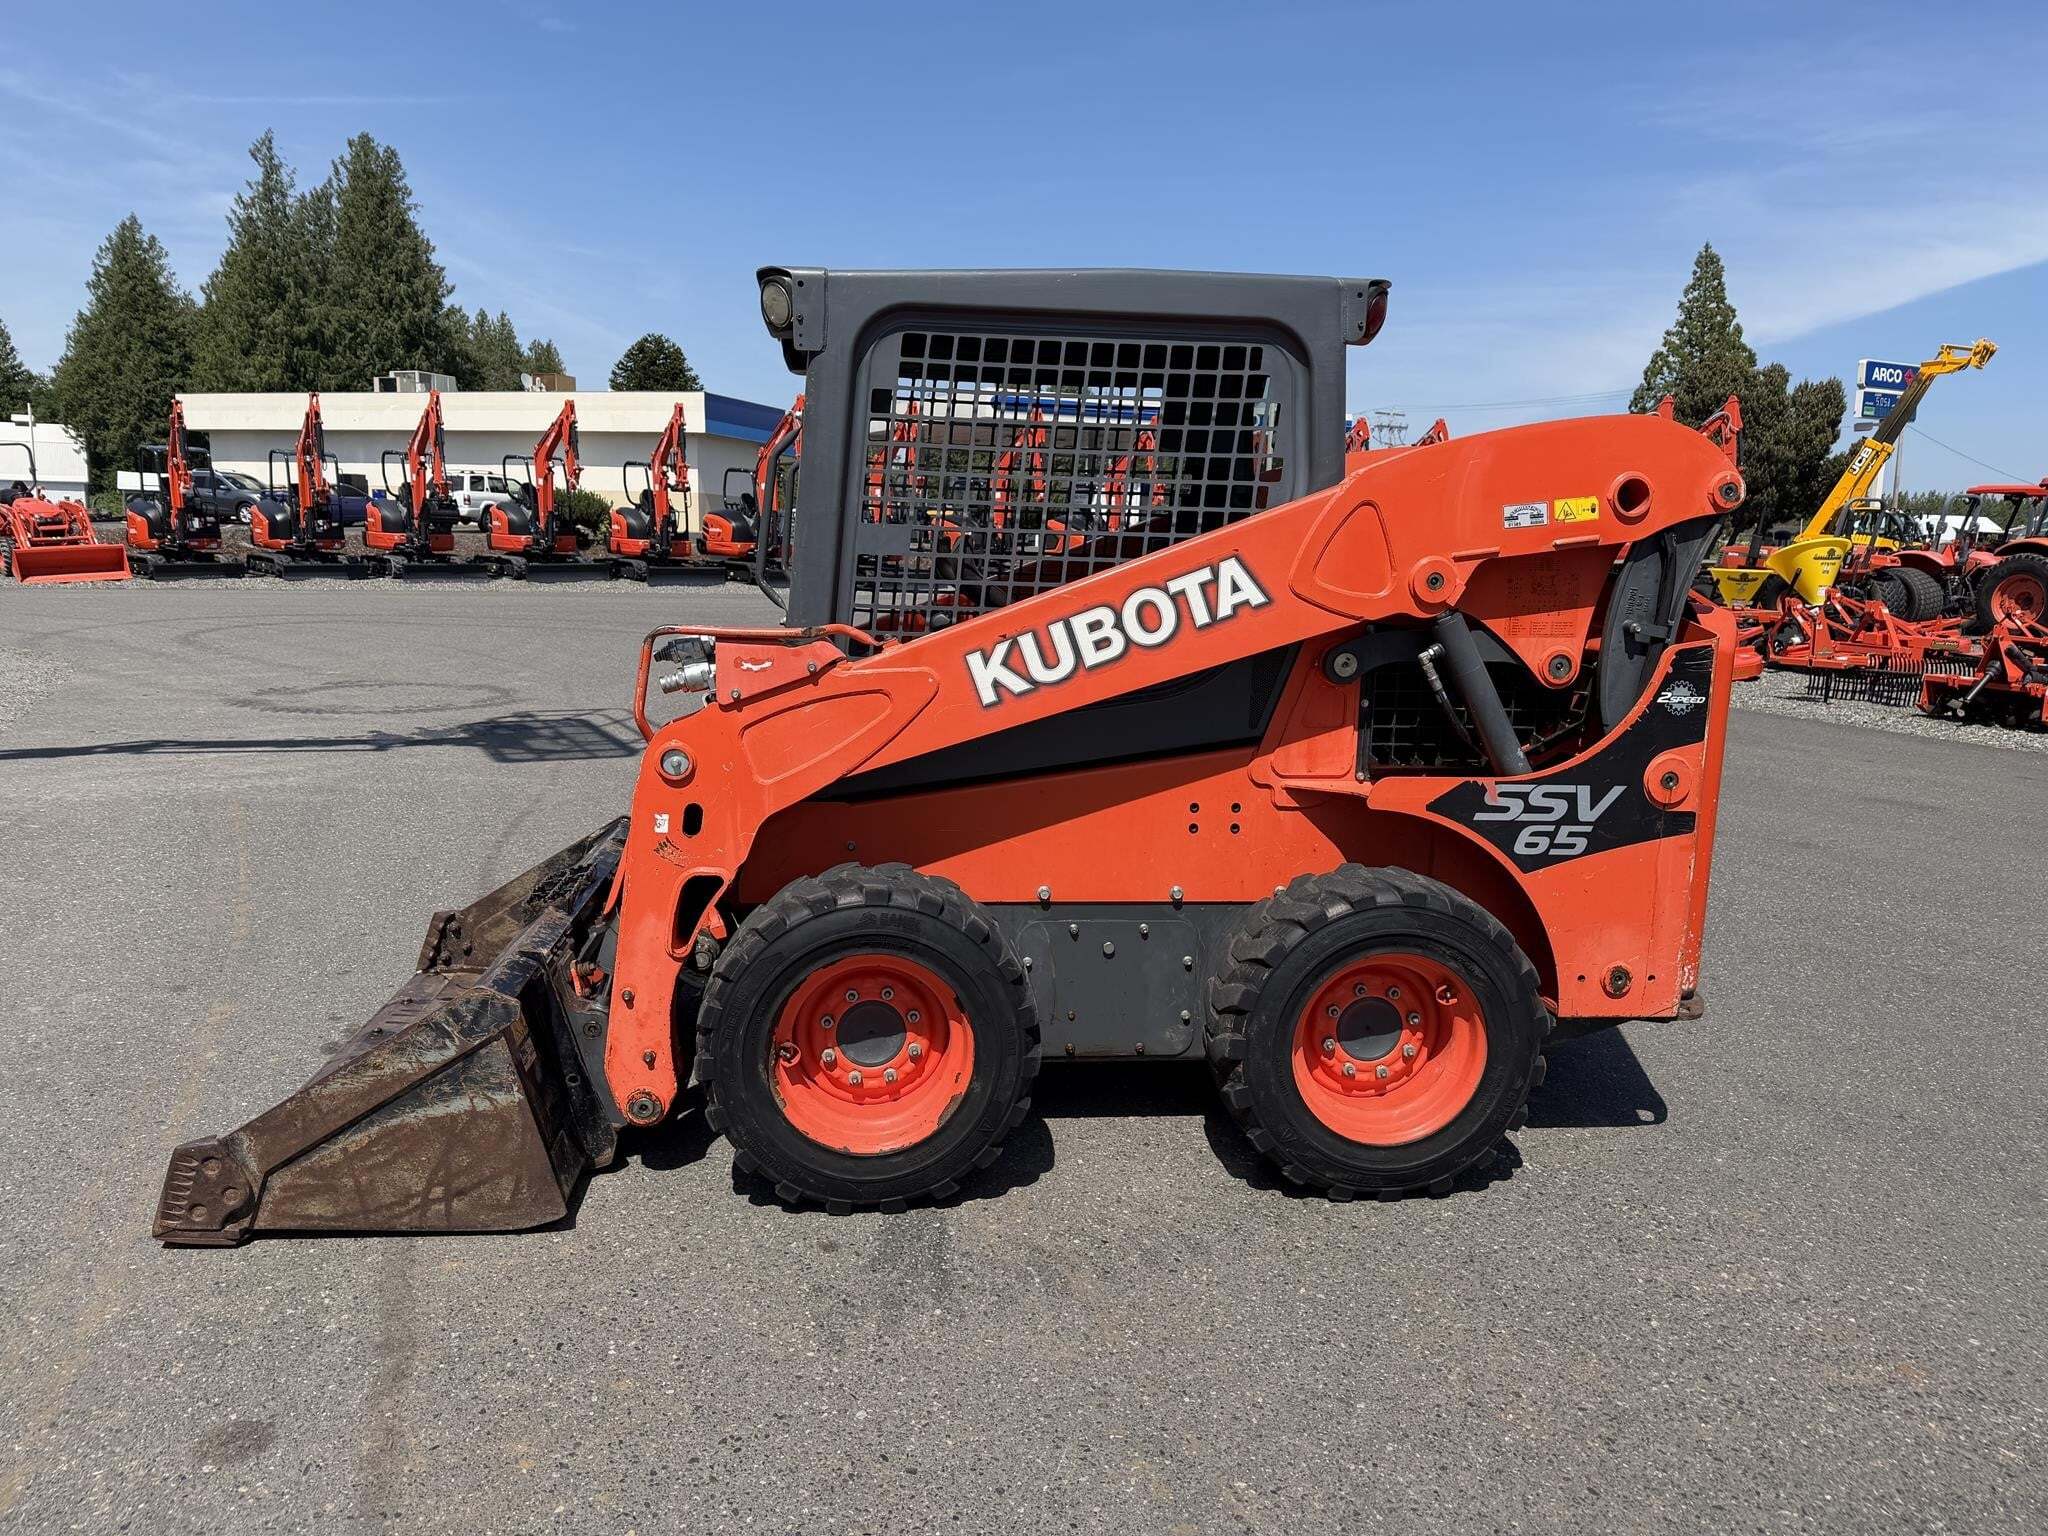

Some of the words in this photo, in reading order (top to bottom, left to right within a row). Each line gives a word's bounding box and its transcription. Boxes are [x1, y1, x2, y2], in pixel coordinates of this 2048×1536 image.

[1872, 366, 1902, 383] ARCO
[1850, 447, 1873, 475] JCB
[965, 557, 1269, 707] KUBOTA
[1473, 784, 1628, 822] SSV
[1513, 825, 1593, 856] 65
